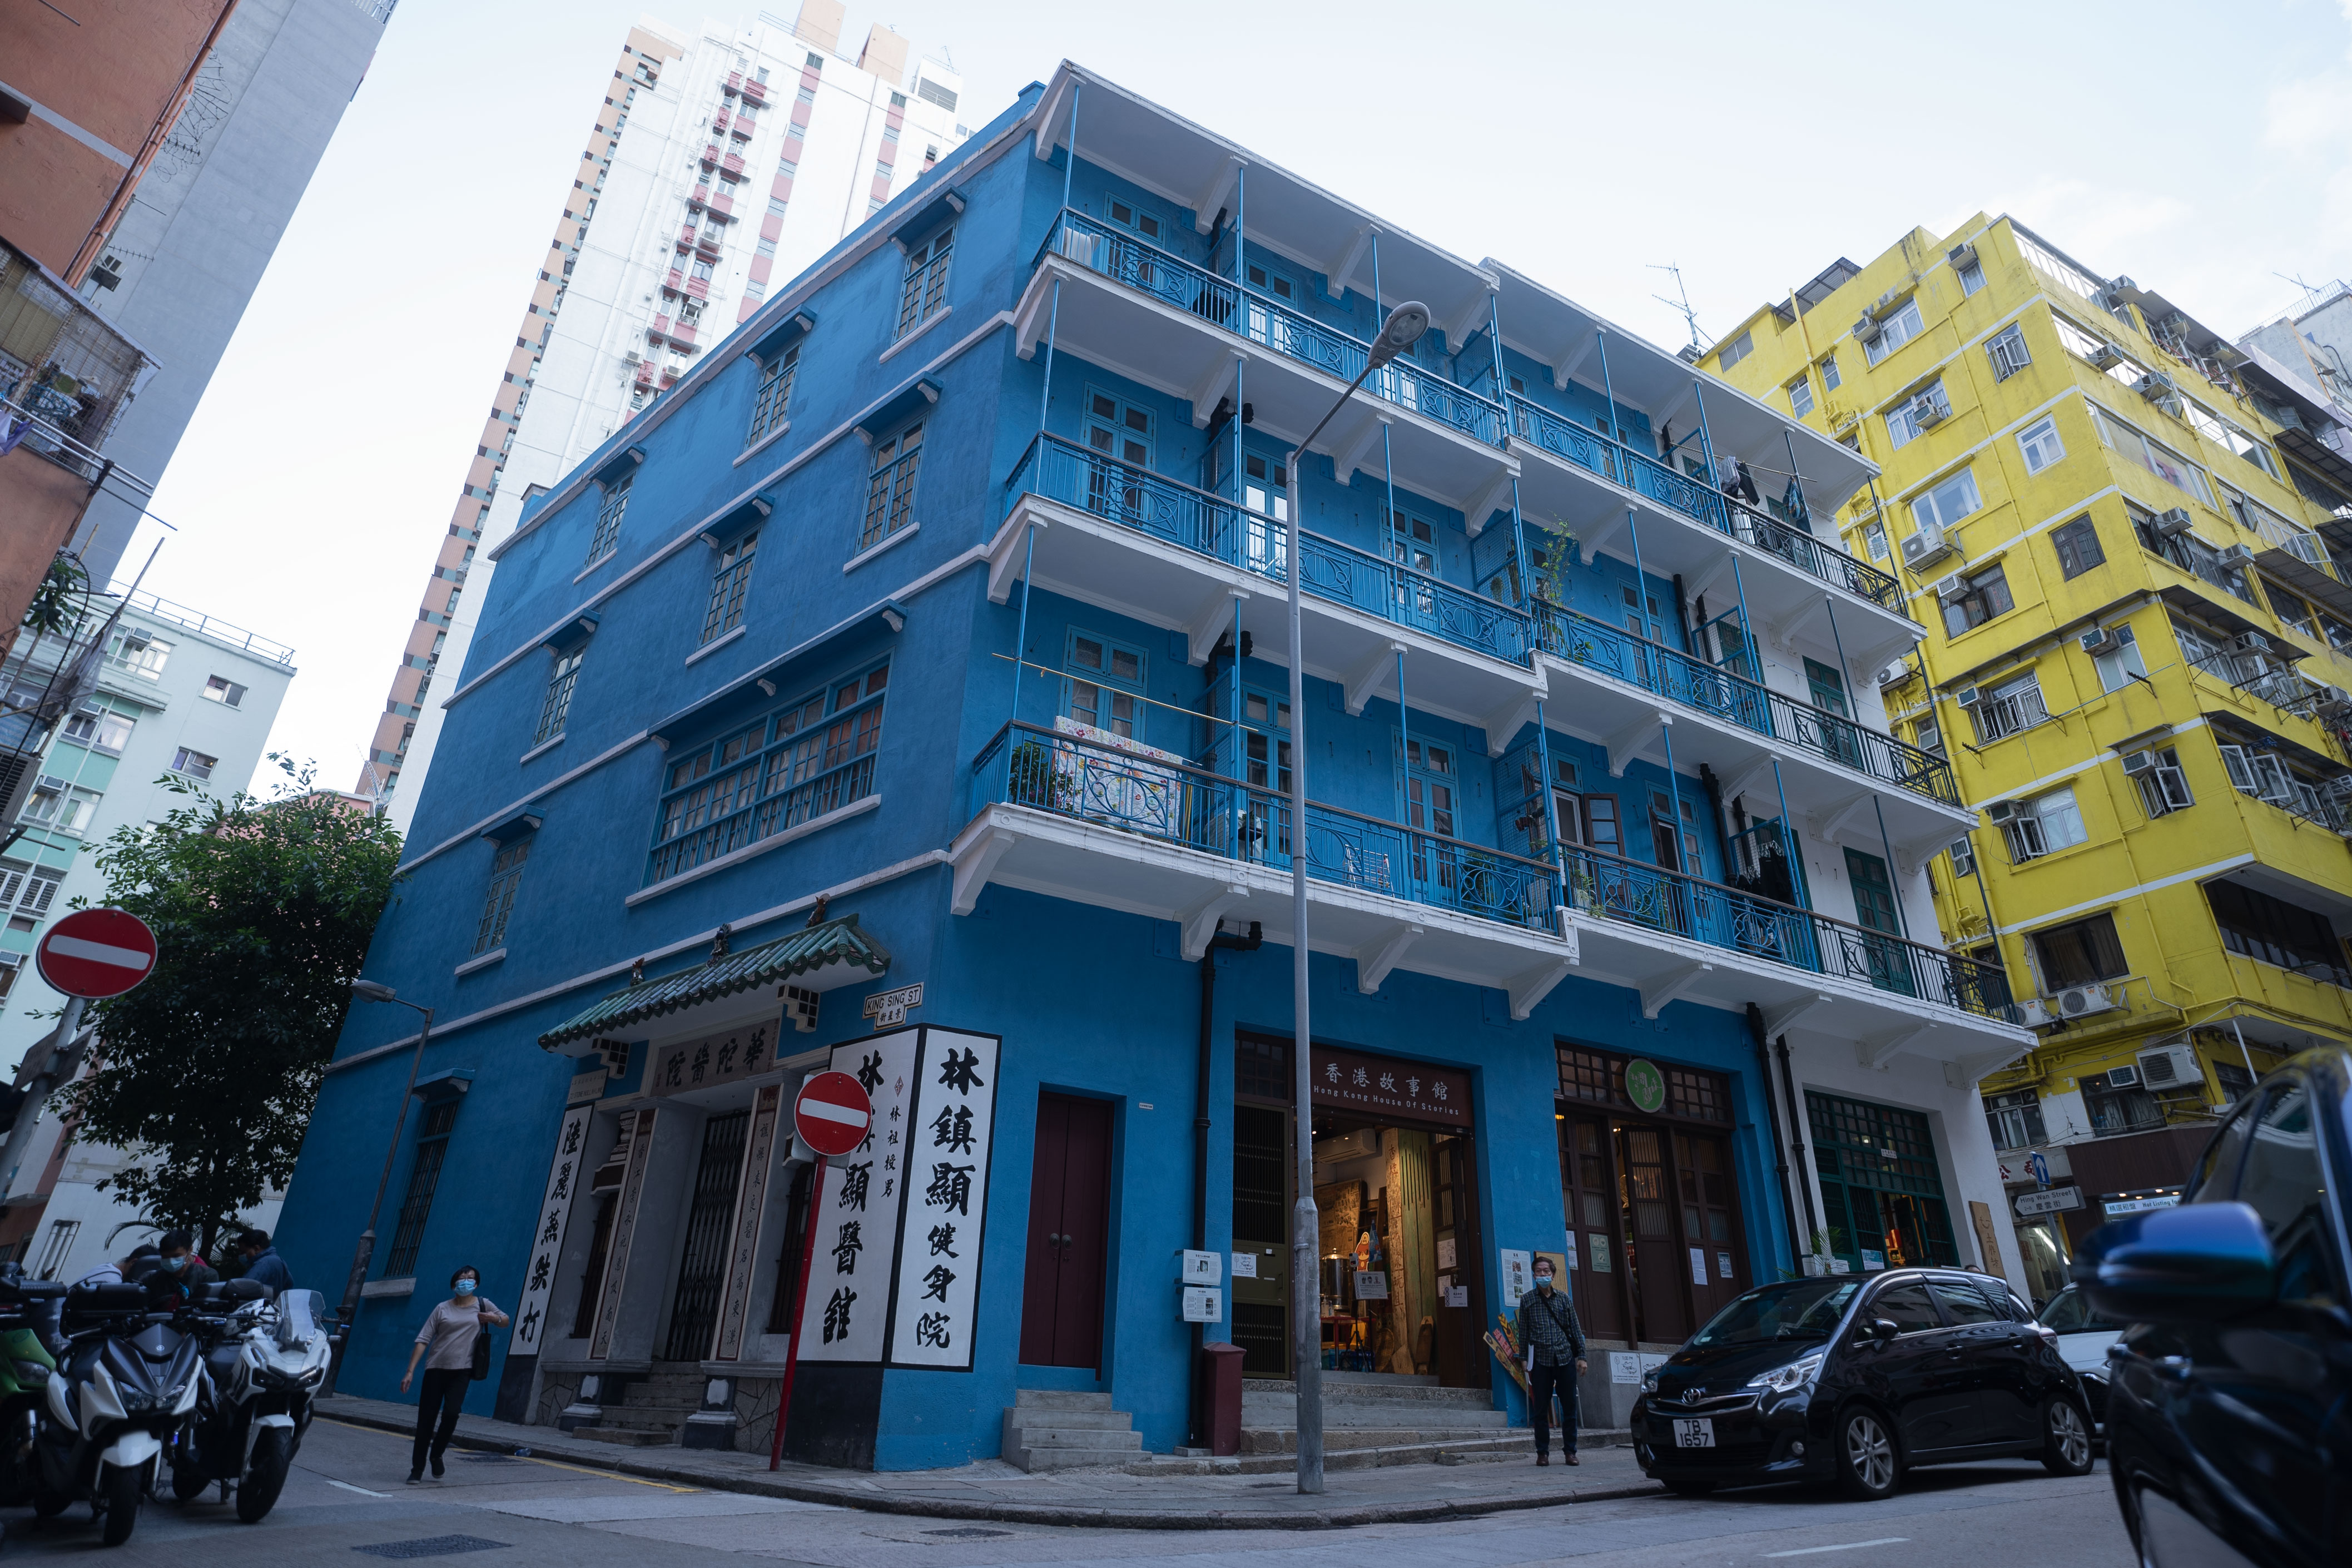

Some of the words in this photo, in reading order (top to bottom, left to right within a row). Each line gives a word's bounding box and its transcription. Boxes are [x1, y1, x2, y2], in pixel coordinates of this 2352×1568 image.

[867, 998, 885, 1011] KING
[887, 993, 905, 1006] SING
[908, 989, 919, 1001] ST
[1325, 1063, 1448, 1101] 香港故事館
[1314, 1085, 1338, 1097] Hong
[1343, 1090, 1367, 1101] Kong
[1373, 1095, 1401, 1106] House
[1422, 1103, 1459, 1115] Stories
[916, 1047, 984, 1349] 林鎮顯健身院
[2036, 1200, 2061, 1210] 慶雲街
[2109, 1203, 2136, 1212] 精選租盤
[1684, 1420, 1701, 1433] TB
[1680, 1433, 1709, 1446] 1657
